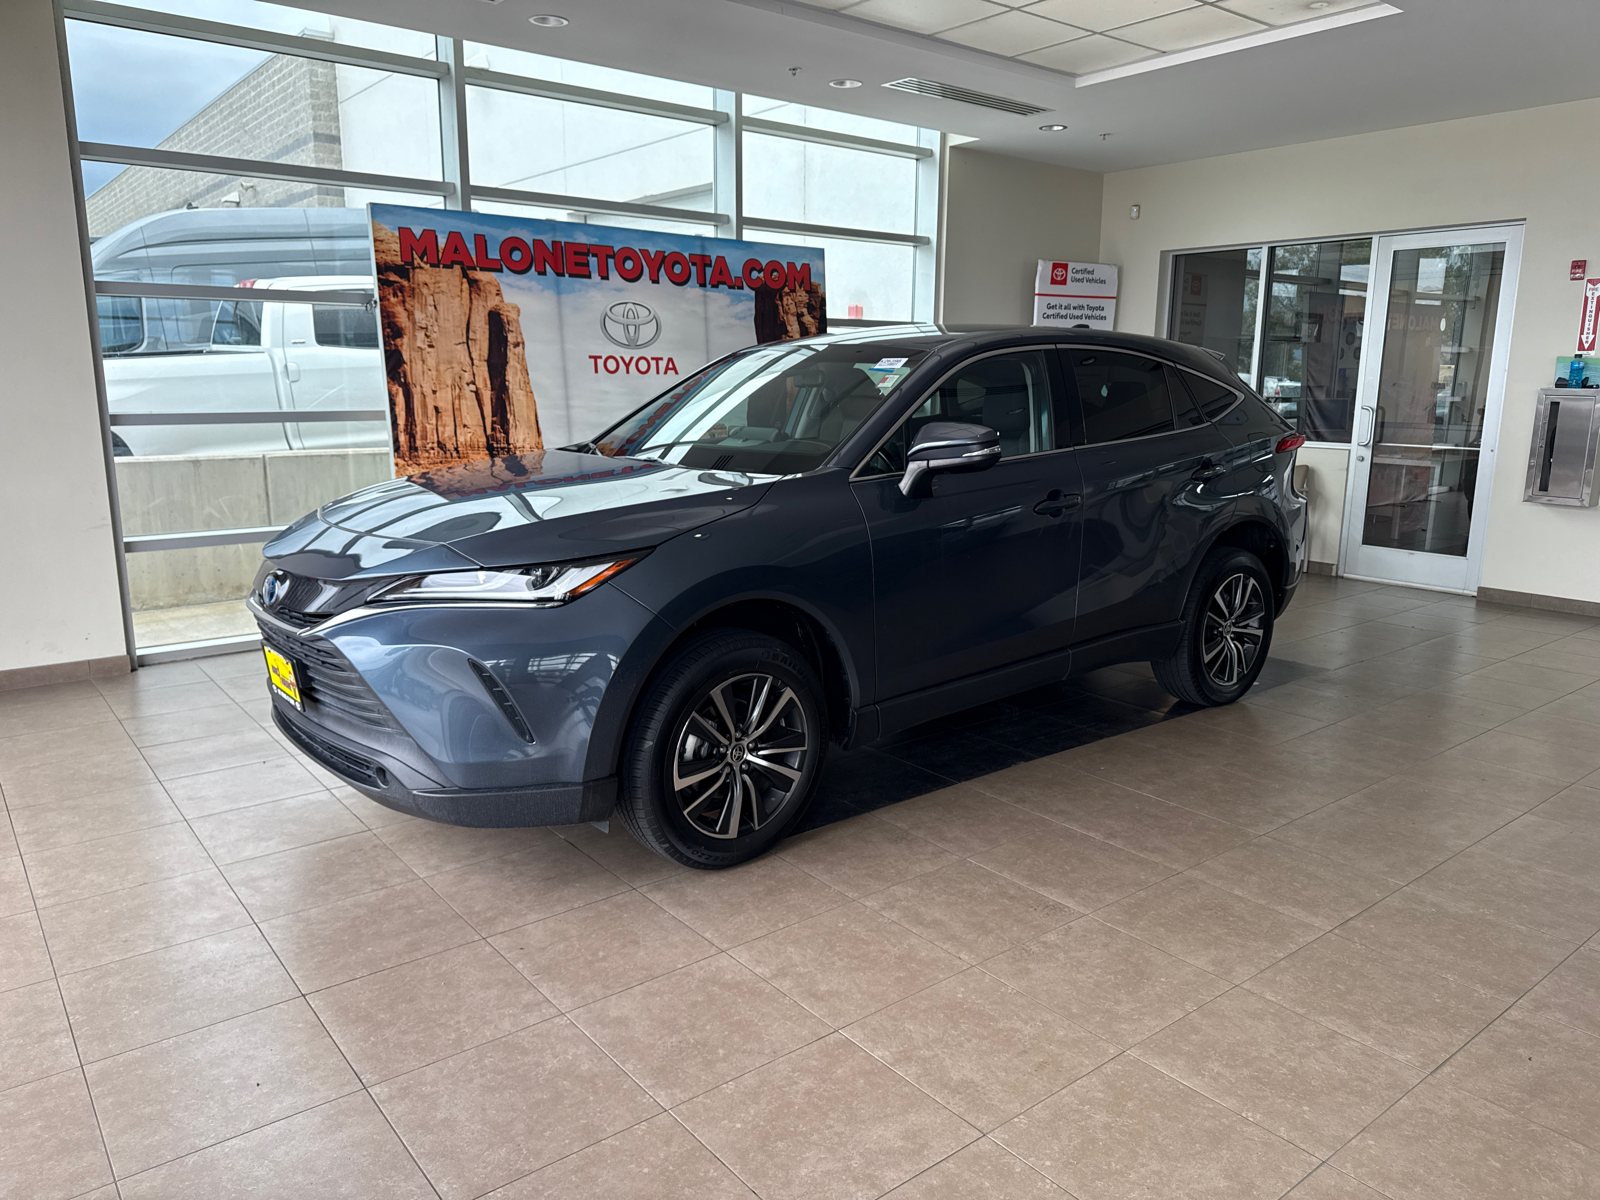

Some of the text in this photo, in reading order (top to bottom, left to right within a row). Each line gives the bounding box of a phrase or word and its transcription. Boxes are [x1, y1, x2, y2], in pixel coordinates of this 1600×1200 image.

[398, 227, 812, 292] MALONETOYOTA.COM
[1071, 267, 1095, 275] Certified
[1085, 276, 1106, 284] Vehicles
[1058, 303, 1063, 311] it
[1072, 303, 1085, 311] with
[1086, 304, 1104, 313] Toyota
[1042, 312, 1068, 320] Certified
[1084, 313, 1107, 321] Vehicles
[1585, 292, 1595, 344] EXTINGUISHER
[588, 354, 680, 376] TOYOTA
